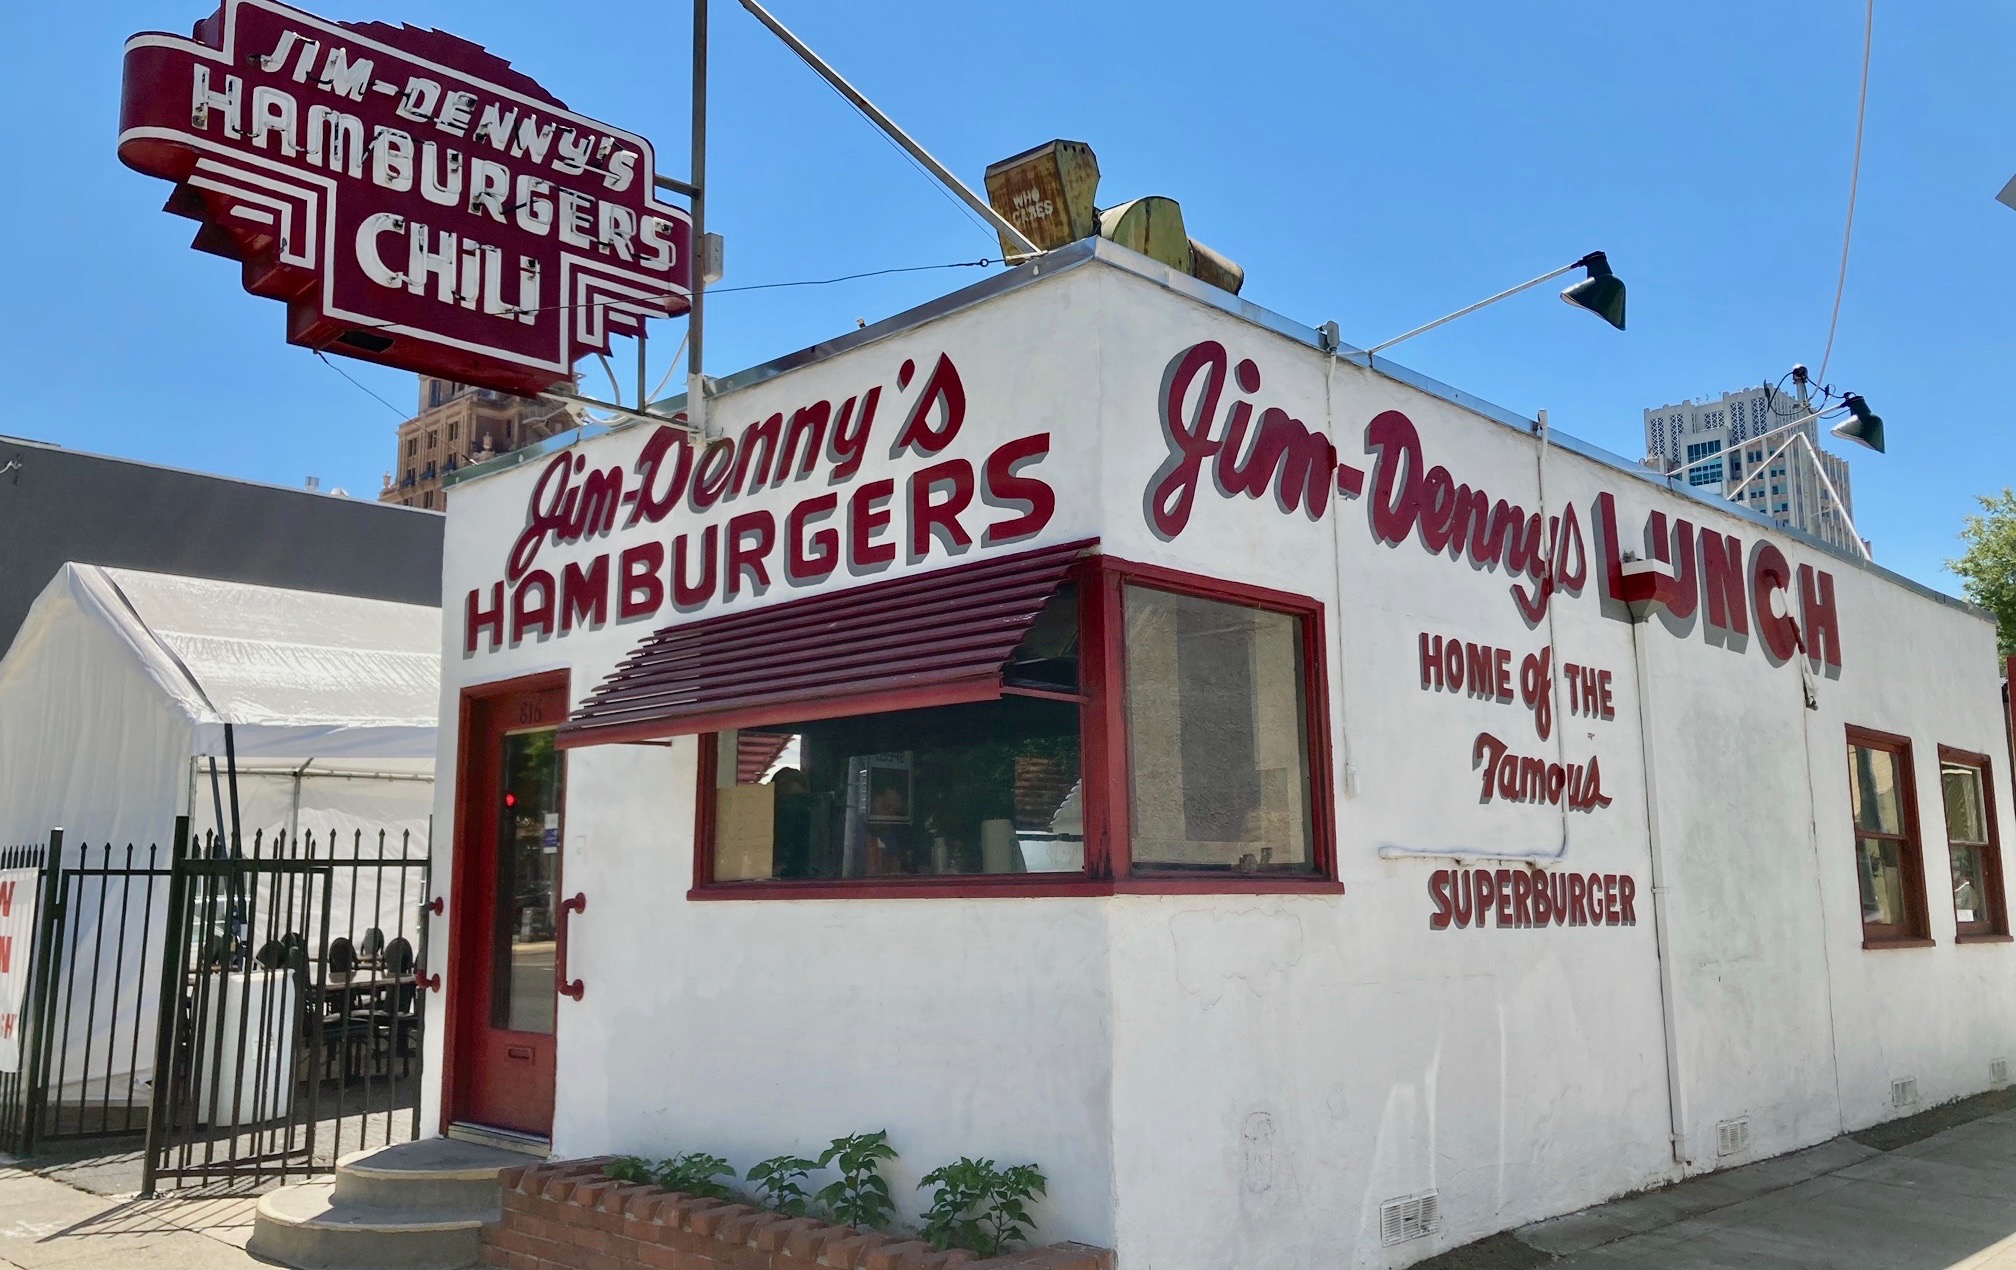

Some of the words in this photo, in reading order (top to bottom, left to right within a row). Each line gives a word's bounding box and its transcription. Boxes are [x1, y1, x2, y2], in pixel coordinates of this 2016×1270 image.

[191, 62, 677, 272] HAMBURGERS
[463, 431, 1057, 660] HAMBURGERS
[1591, 491, 1842, 681] LUNCH
[1418, 632, 1514, 705] HOME
[1564, 663, 1615, 721] THE
[1472, 732, 1613, 814] Famous
[1428, 869, 1637, 931] SUPERBURGER
